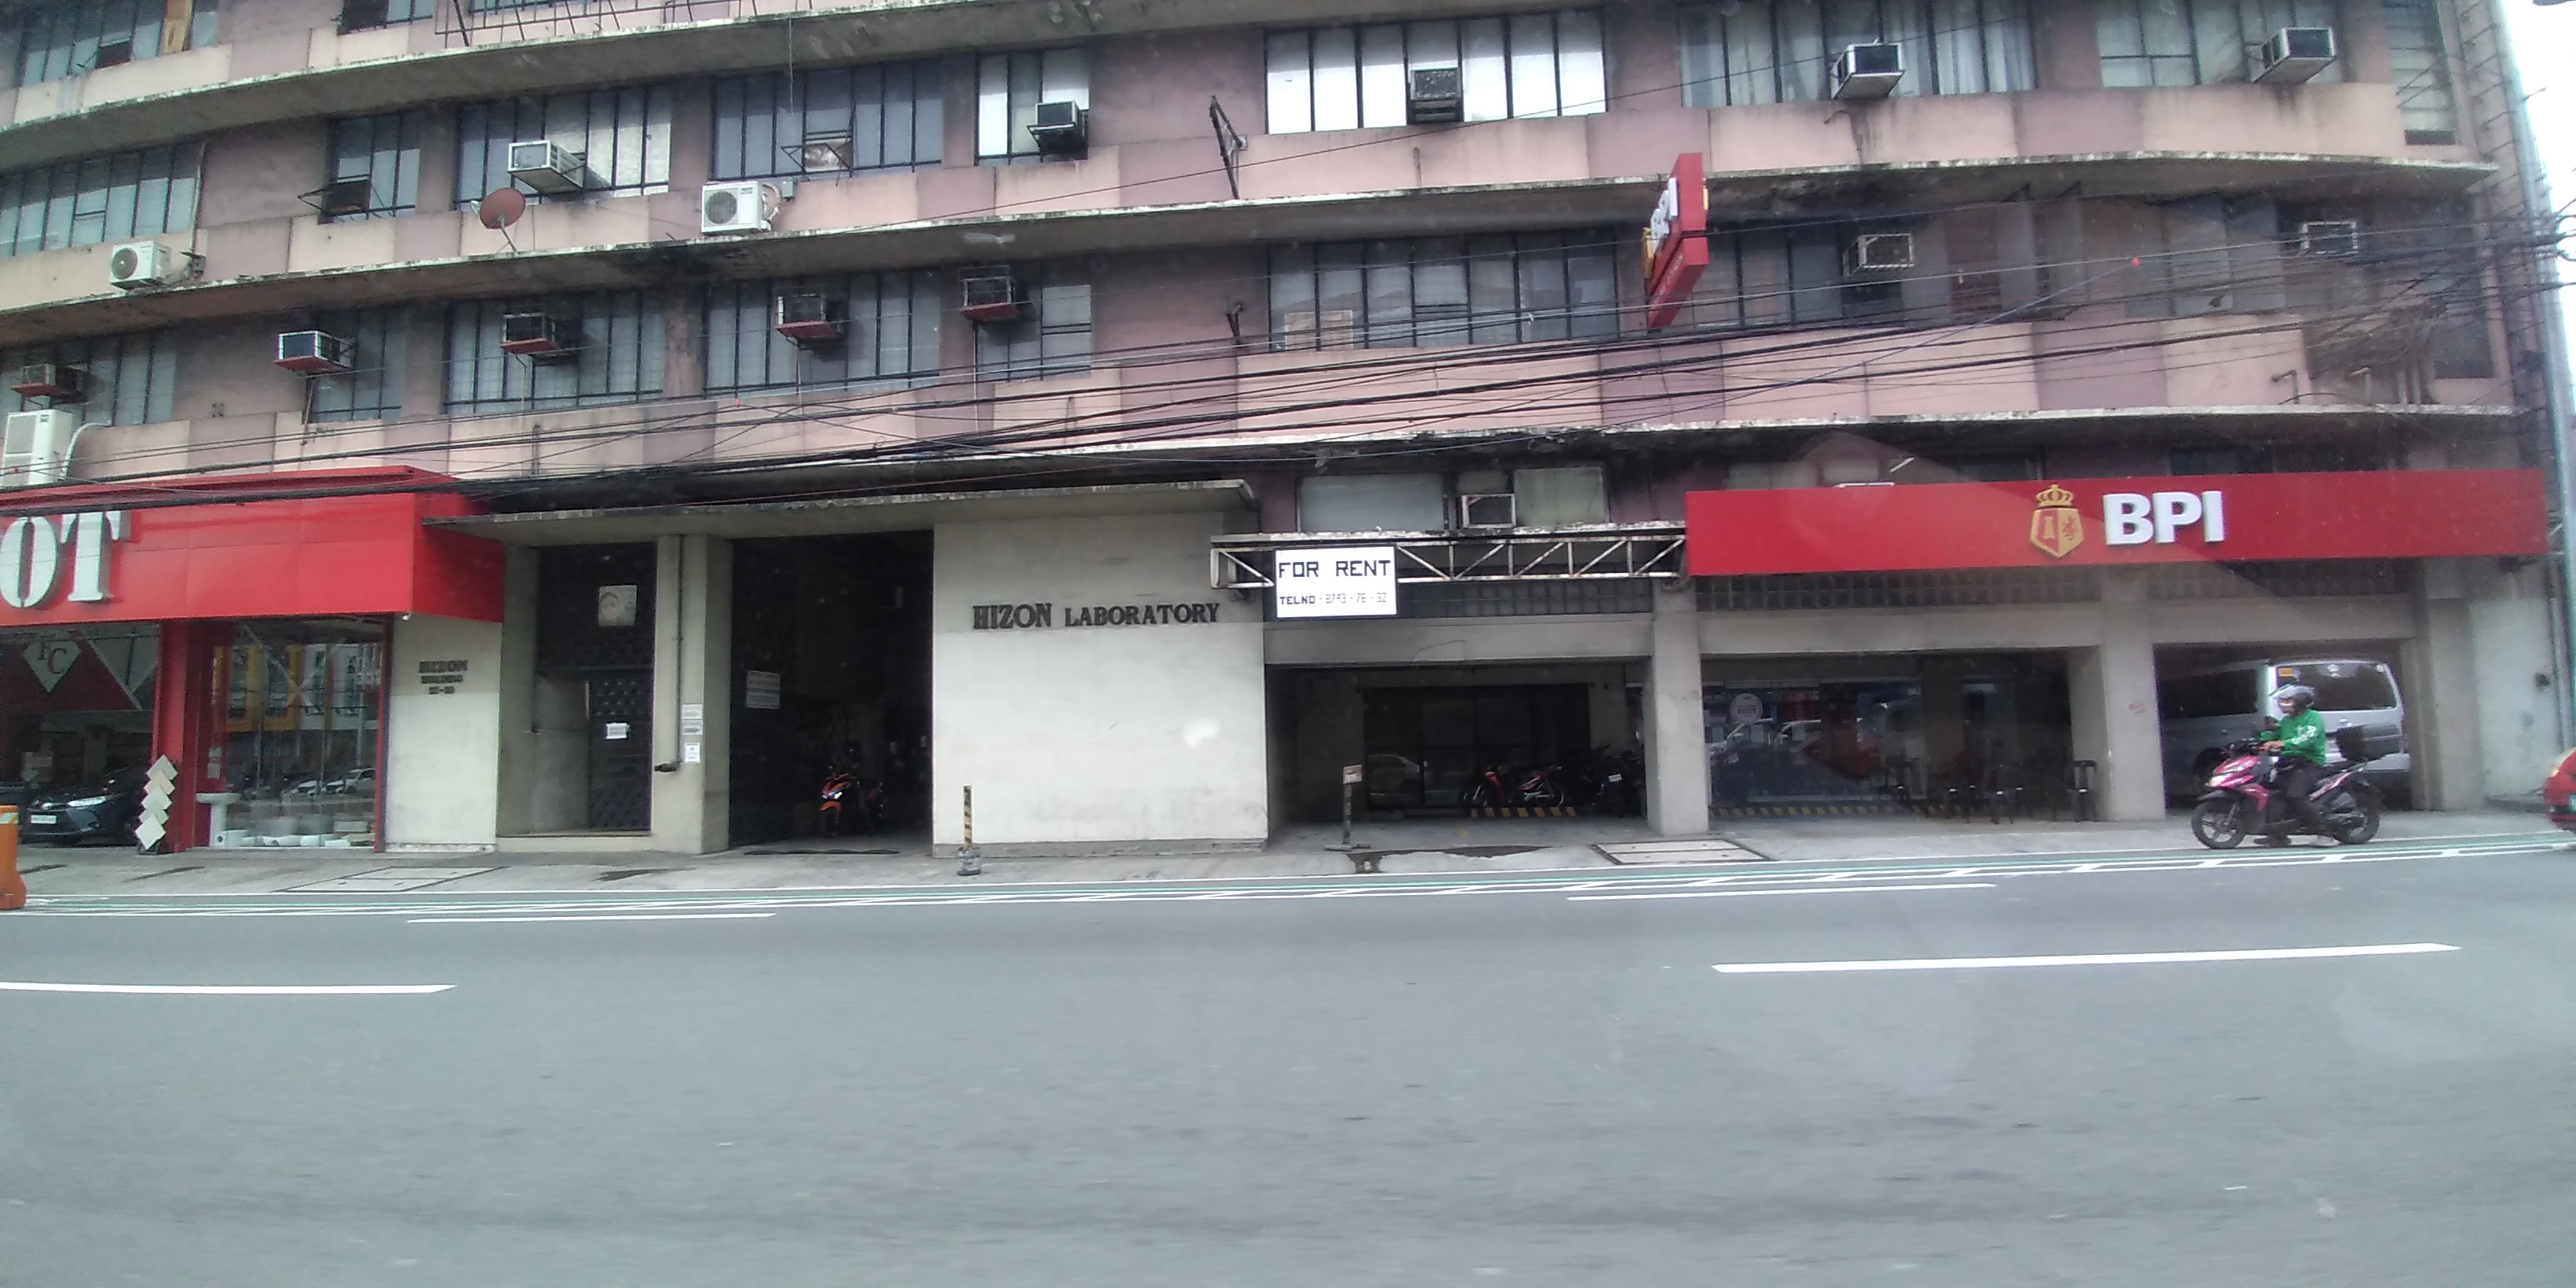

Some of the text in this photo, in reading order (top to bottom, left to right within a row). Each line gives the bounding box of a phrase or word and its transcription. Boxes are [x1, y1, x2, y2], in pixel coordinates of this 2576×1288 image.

[2102, 490, 2225, 545] BPI
[1279, 560, 1391, 578] FOR RENT
[972, 602, 1220, 630] HIZON LABORATORY
